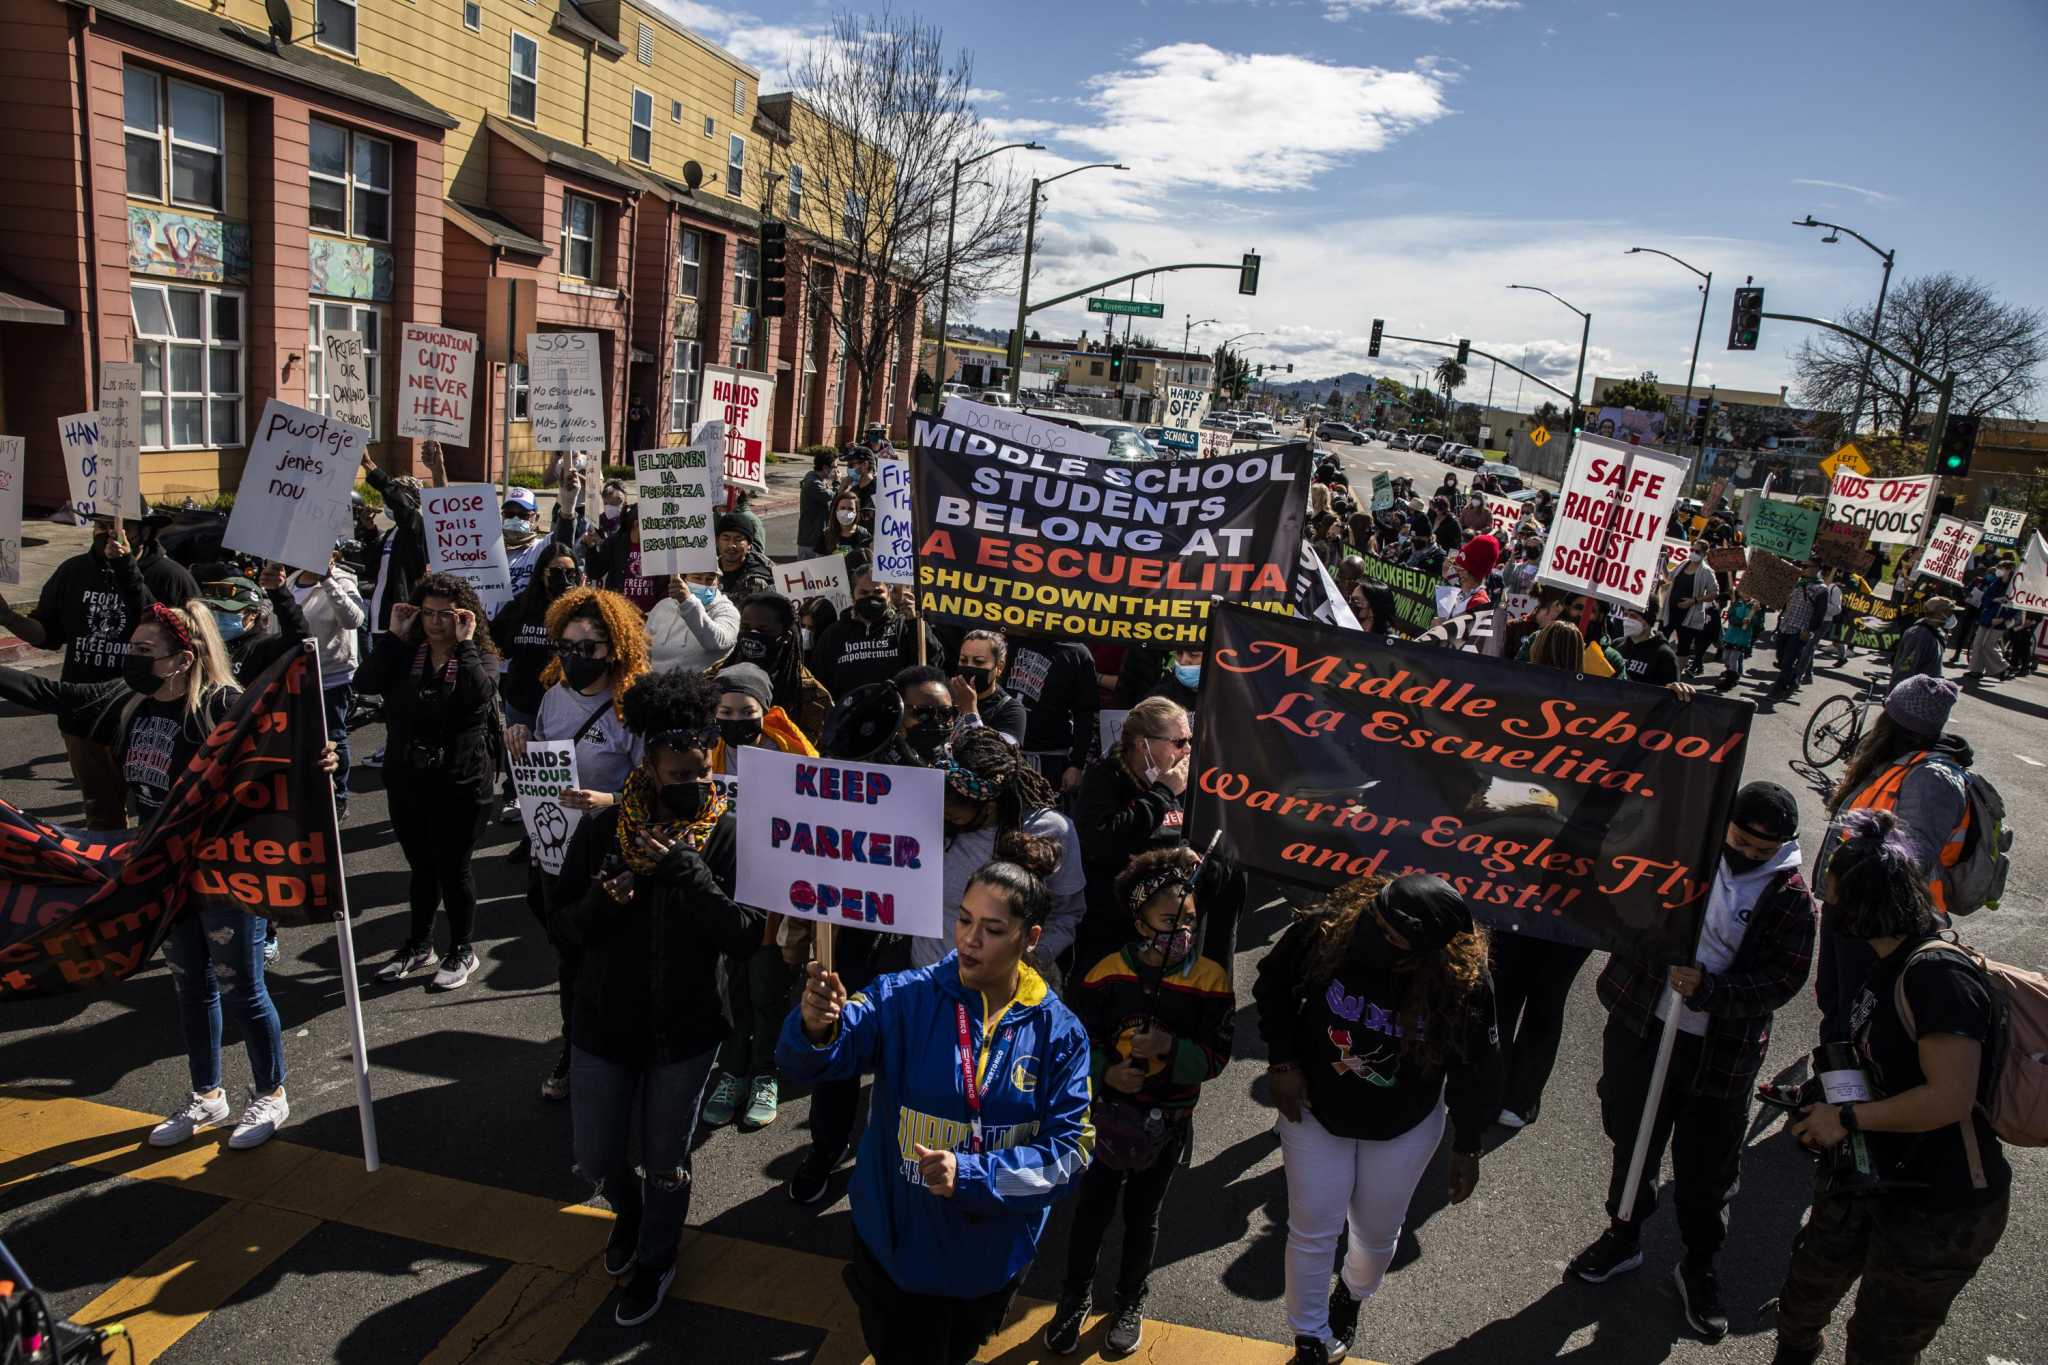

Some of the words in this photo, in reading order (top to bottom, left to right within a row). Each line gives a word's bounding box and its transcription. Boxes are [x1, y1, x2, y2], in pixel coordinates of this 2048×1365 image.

[326, 335, 361, 362] PROTECT
[407, 329, 473, 353] EDUCATION
[535, 334, 585, 351] SOS
[340, 364, 360, 380] OUR
[418, 348, 457, 375] CUTS
[408, 374, 468, 400] NEVER
[713, 380, 760, 408] HANDS
[1170, 387, 1203, 401] HANDS
[413, 396, 465, 421] HEAL
[724, 405, 749, 428] OFF
[1169, 399, 1200, 418] OFF
[65, 421, 99, 447] HAN
[1163, 430, 1195, 445] SCHOOLS
[914, 418, 1089, 478] MIDDLE
[1103, 453, 1296, 488] SCHOOL
[82, 454, 98, 477] OF
[724, 456, 761, 481] OOLS
[882, 464, 912, 488] FIR
[268, 479, 306, 499] nou
[660, 471, 677, 484] LA
[1587, 458, 1665, 500] SAFE
[1832, 474, 1874, 499] ANDS
[1879, 480, 1927, 504] OFF
[640, 483, 705, 499] POBREZA
[885, 488, 912, 509] TH
[971, 465, 1226, 527] STUDENTS
[1605, 488, 1632, 503] AND
[429, 496, 484, 515] Close
[662, 502, 680, 516] NO
[1563, 492, 1663, 542] RACIALLY
[1990, 509, 2023, 521] HANDS
[435, 518, 477, 533] Jails
[642, 514, 707, 531] NUESTRAS
[881, 514, 912, 537] CAM
[936, 495, 1163, 552] BELONG
[1179, 527, 1254, 557] AT
[1841, 504, 1924, 535] SCHOOLS
[438, 534, 483, 547] NOT
[643, 534, 709, 552] ESCUELAS
[1579, 528, 1635, 562] JUST
[1943, 525, 1976, 545] SAFE
[1983, 534, 2015, 546] SCHOOLS
[440, 550, 487, 562] Schools
[891, 539, 912, 556] FO
[1931, 538, 1970, 561] RACIALLY
[1936, 550, 1960, 567] JUST
[877, 555, 913, 572] ROOT
[919, 529, 957, 561] A
[976, 536, 1289, 593] ESCUELITA
[1552, 546, 1647, 596] SCHOOLS
[1924, 559, 1965, 582] SCHOOLS
[784, 571, 840, 593] Hands
[1364, 554, 1427, 595] BROOKFIELD
[1392, 592, 1415, 620] OWN
[845, 638, 889, 652] homies
[1215, 640, 1497, 718] Middle
[1500, 699, 1745, 765] School
[1255, 692, 1345, 738] La
[1361, 709, 1656, 799] Escuelita.
[515, 768, 536, 782] OFF
[538, 768, 572, 783] OUR
[795, 763, 892, 805] KEEP
[771, 816, 922, 870] PARKER
[1199, 765, 1411, 838] Warrior
[1421, 814, 1595, 877] Eagles
[1598, 854, 1709, 911] Fly
[1280, 841, 1390, 879] and
[789, 879, 895, 926] OPEN
